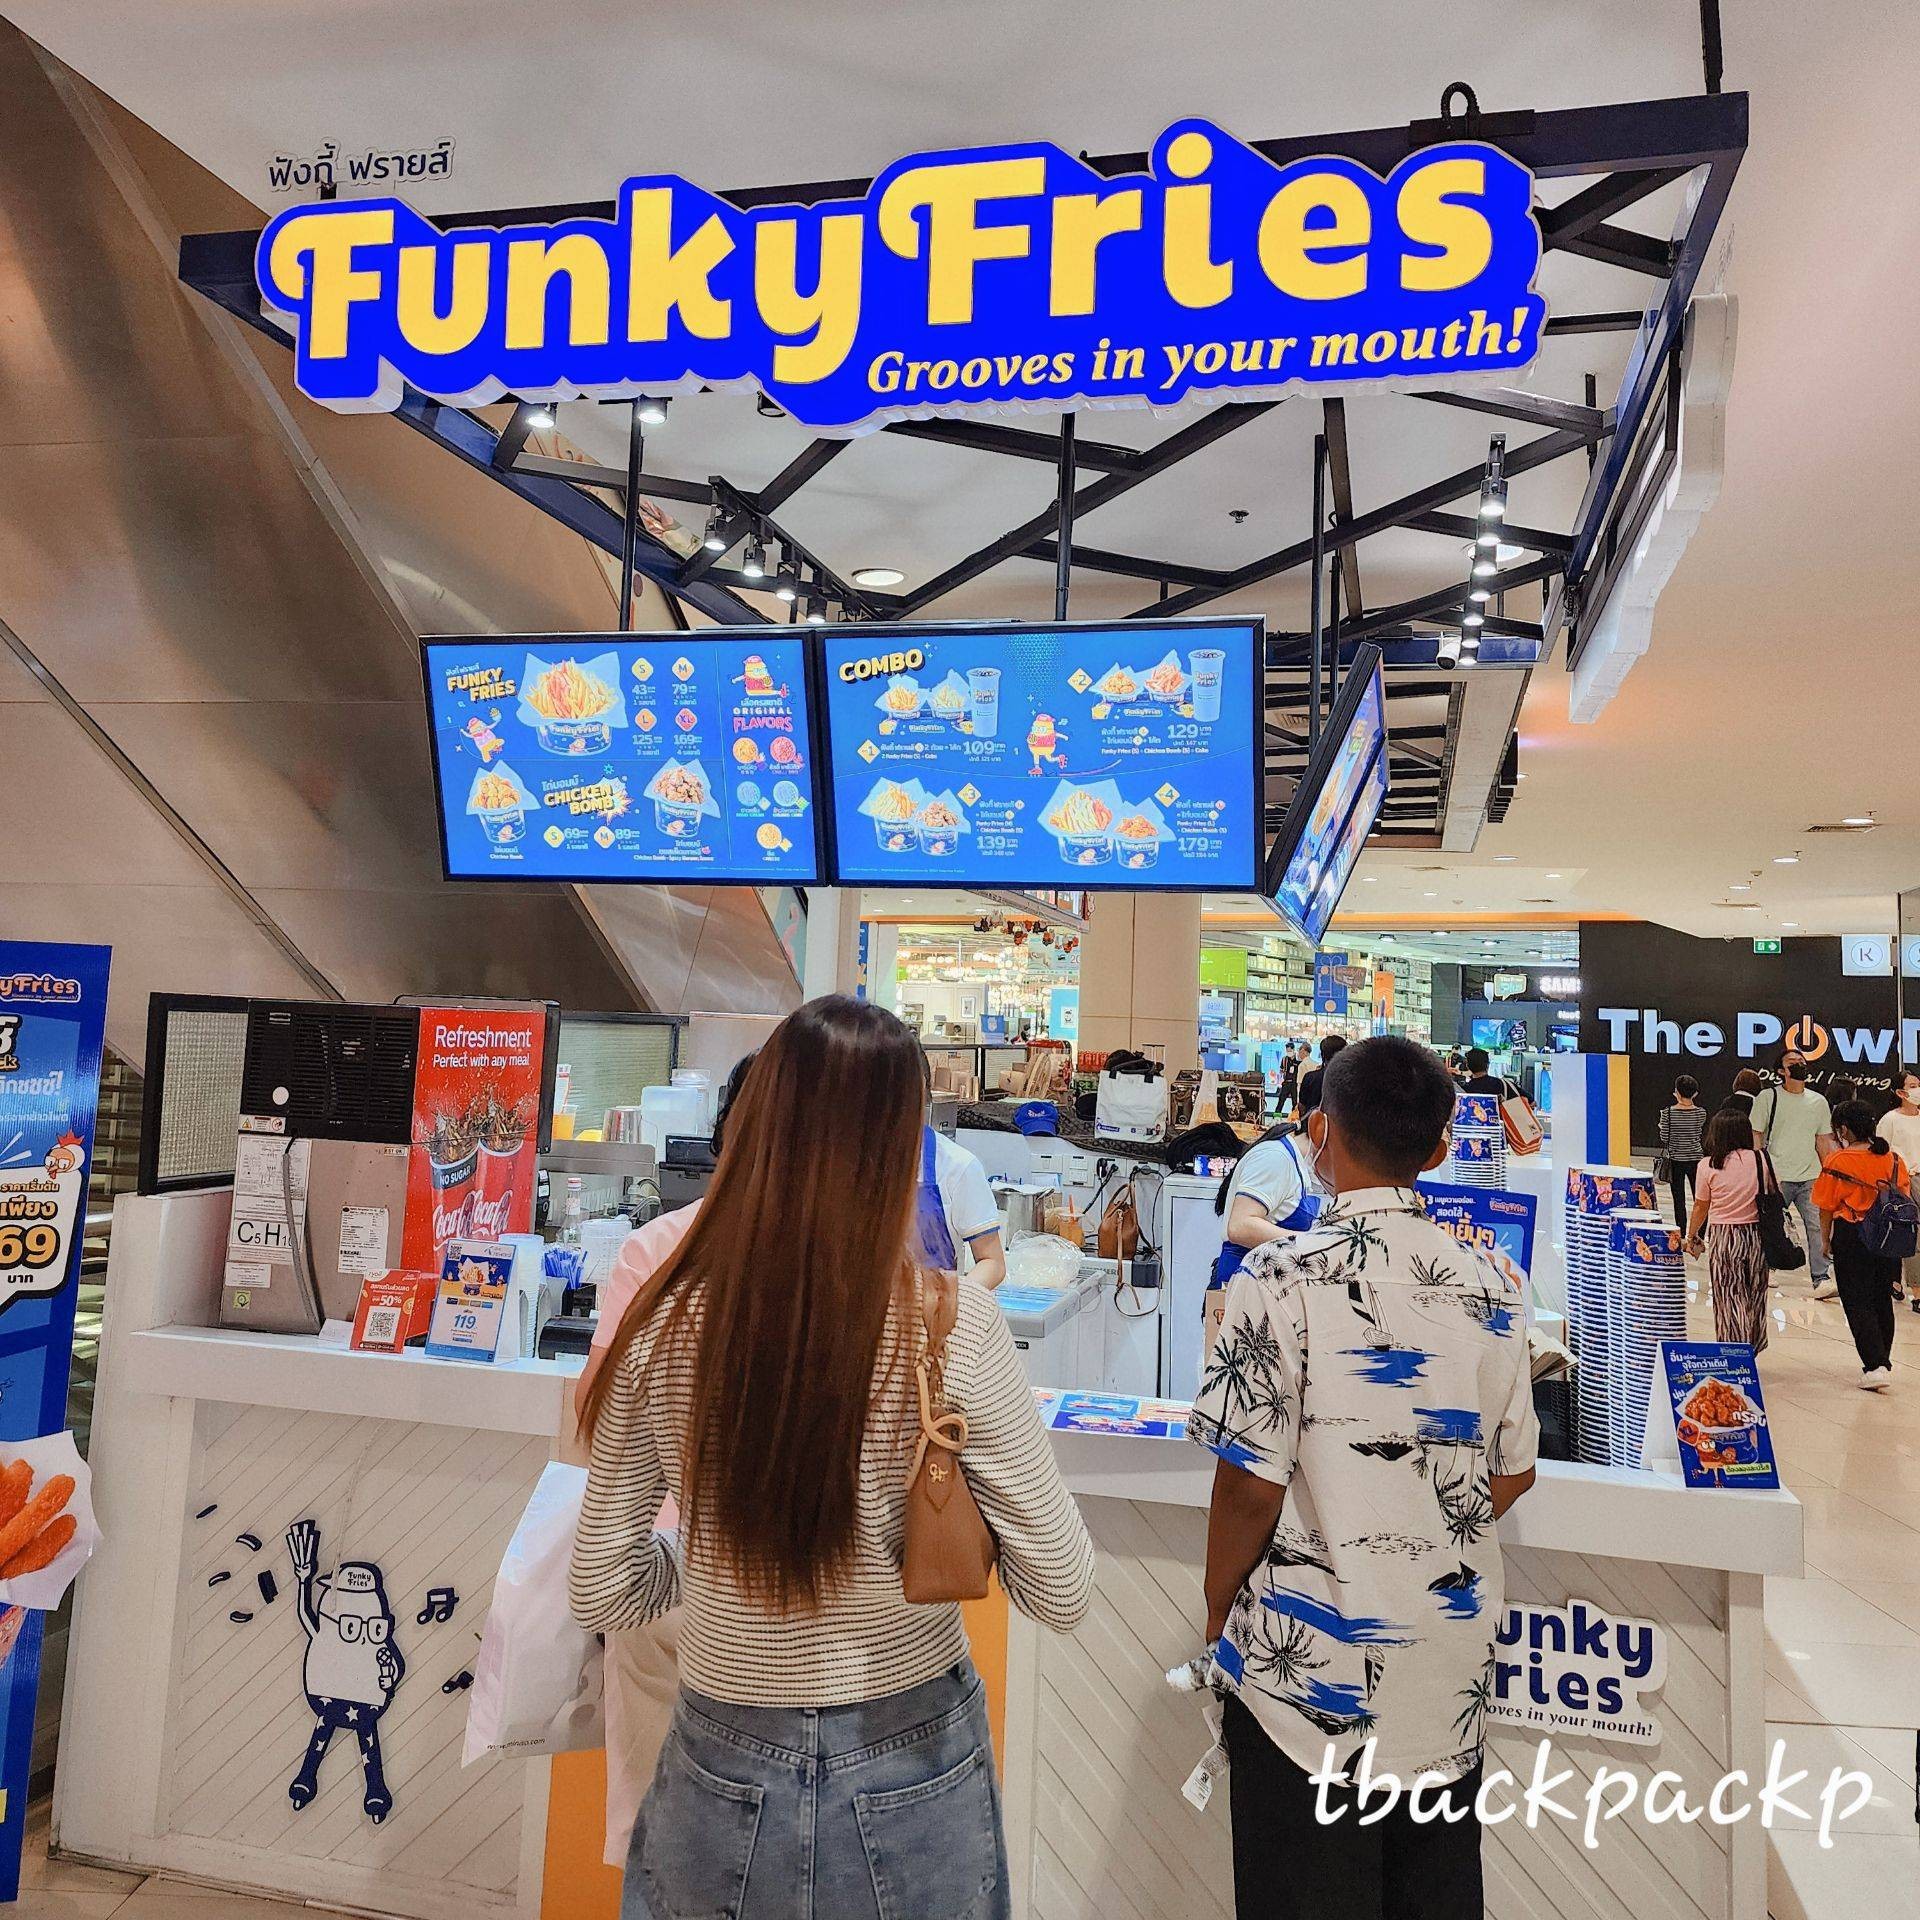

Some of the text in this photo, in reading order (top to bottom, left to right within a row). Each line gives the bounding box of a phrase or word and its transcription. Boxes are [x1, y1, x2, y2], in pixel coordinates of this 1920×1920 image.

[269, 142, 450, 187] ฟังกี้ ฟรายส์
[868, 306, 1530, 394] Grooves in your mouth!
[638, 664, 646, 674] S
[838, 648, 924, 682] COMBO
[447, 667, 503, 692] FUNKY
[1078, 674, 1087, 686] 2
[470, 679, 517, 701] FRIES
[632, 684, 648, 695] 43
[672, 683, 688, 695] 79
[732, 707, 793, 715] ORIGINAL
[642, 715, 649, 724] L
[732, 715, 794, 734] FLAVORS
[1167, 725, 1198, 738] 129
[632, 735, 653, 745] 125
[673, 735, 696, 745] 169
[963, 741, 994, 755] 109
[543, 783, 614, 807] CHICKEN
[569, 798, 615, 816] BOMB
[564, 828, 580, 839] 69
[614, 828, 631, 839] 89
[976, 836, 1006, 850] 139
[1177, 837, 1209, 851] 179
[434, 1025, 533, 1049] Refreshment
[1598, 1008, 1725, 1057] The
[432, 1053, 530, 1069] Perfect with any meal
[439, 1165, 471, 1187] NO SUGAR
[0, 1226, 58, 1264] 69
[7, 1274, 34, 1284] บาท
[380, 1294, 402, 1306] 50%
[347, 1571, 372, 1582] Funky
[347, 1578, 368, 1587] Fries
[1496, 1604, 1653, 1679] unky
[1496, 1651, 1623, 1715] ries
[1527, 1707, 1544, 1721] in
[1549, 1713, 1588, 1726] your
[1592, 1720, 1653, 1737] mouth!
